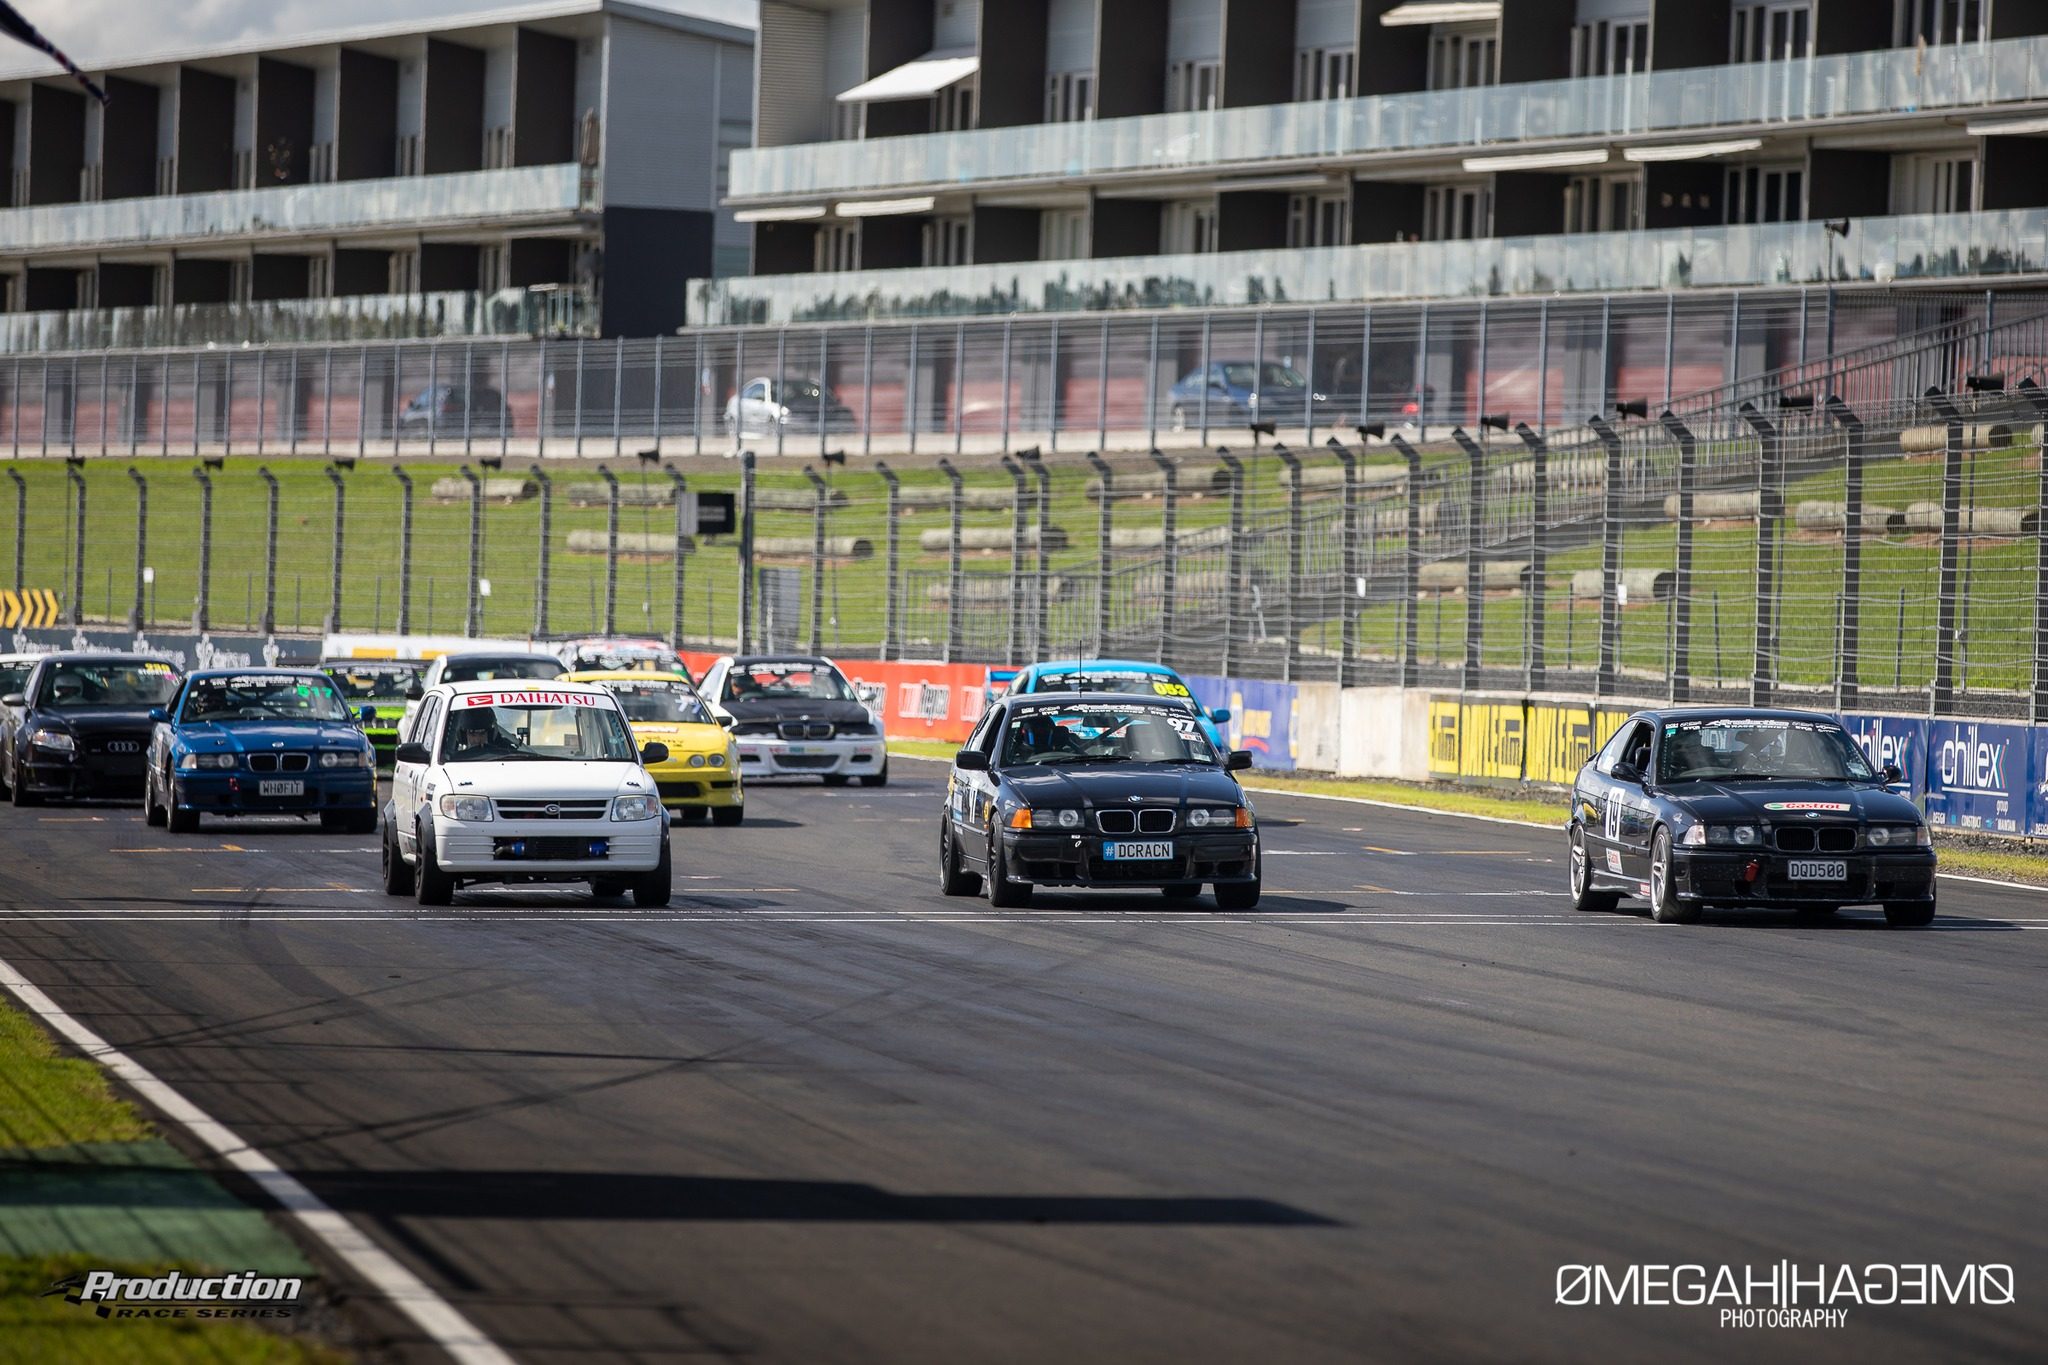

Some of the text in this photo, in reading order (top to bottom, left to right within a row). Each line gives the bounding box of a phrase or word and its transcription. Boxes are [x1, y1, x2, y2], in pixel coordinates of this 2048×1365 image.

[1152, 682, 1189, 697] 053
[500, 692, 595, 706] DAIHATSU
[1167, 718, 1195, 732] 97
[1942, 724, 2000, 788] chillex
[1118, 844, 1170, 858] DCRACN
[1790, 864, 1845, 878] DQD500
